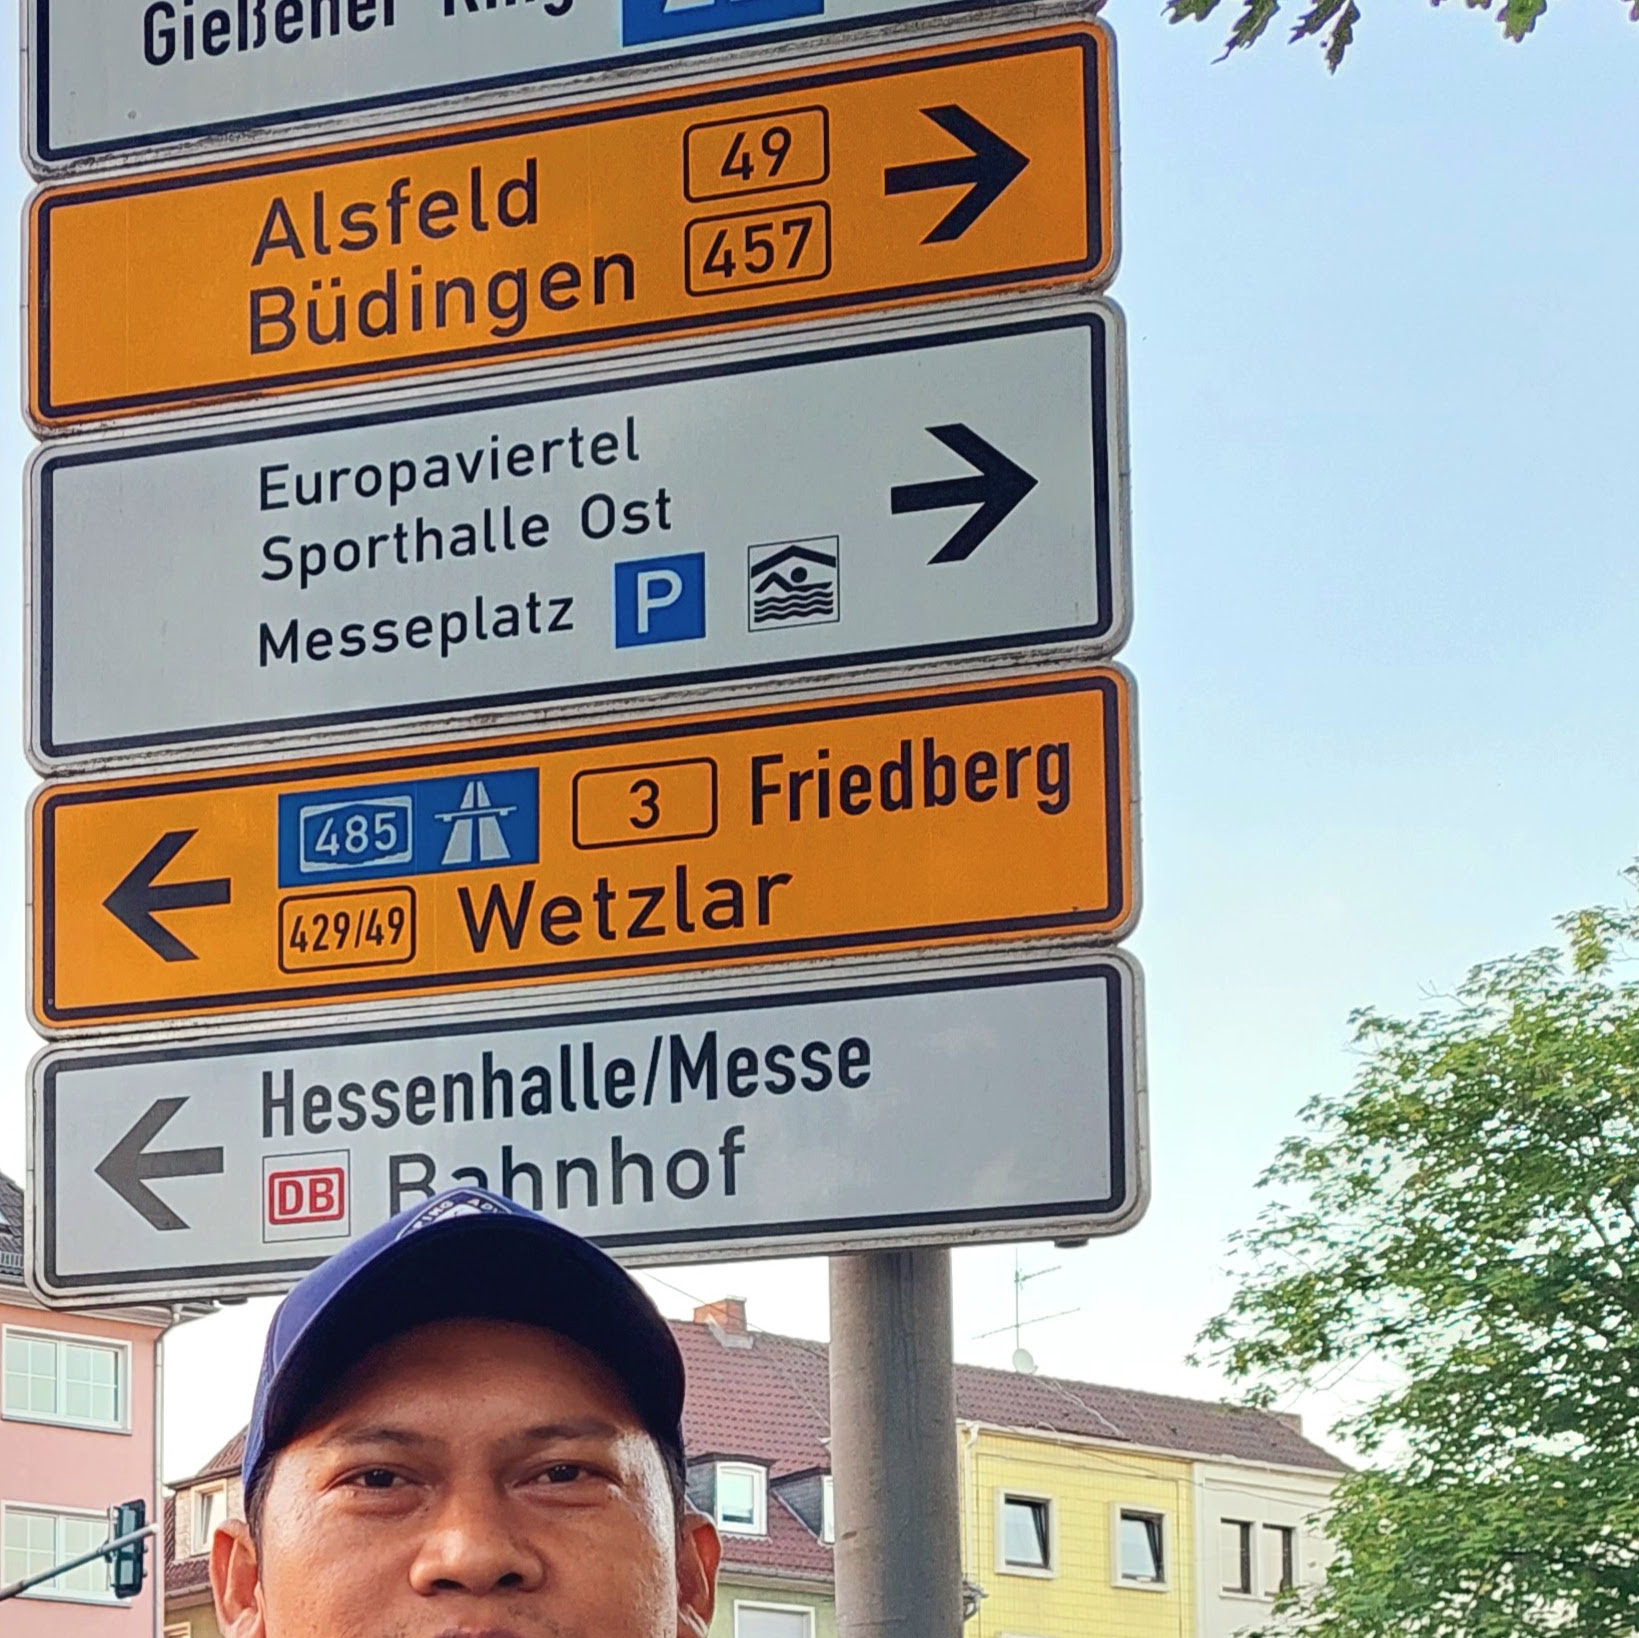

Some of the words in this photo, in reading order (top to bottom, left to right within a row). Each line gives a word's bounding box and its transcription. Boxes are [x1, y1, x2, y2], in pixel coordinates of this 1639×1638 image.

[719, 125, 792, 181] 49
[251, 157, 537, 266] Alsfeld
[702, 216, 813, 278] 457
[249, 253, 635, 354] Büdingen
[260, 416, 640, 511] Europaviertel
[262, 505, 550, 587] Sporthalle
[582, 487, 672, 540] Ost
[259, 592, 574, 667] Messeplatz
[637, 569, 683, 634] P
[629, 778, 660, 830] 3
[751, 736, 1071, 825] Friedberg
[315, 811, 397, 856] 485
[289, 906, 405, 953] 429/49
[458, 866, 794, 954] Wetzlar
[262, 1031, 871, 1138] Hessenhalle/Messe
[278, 1177, 335, 1216] DB
